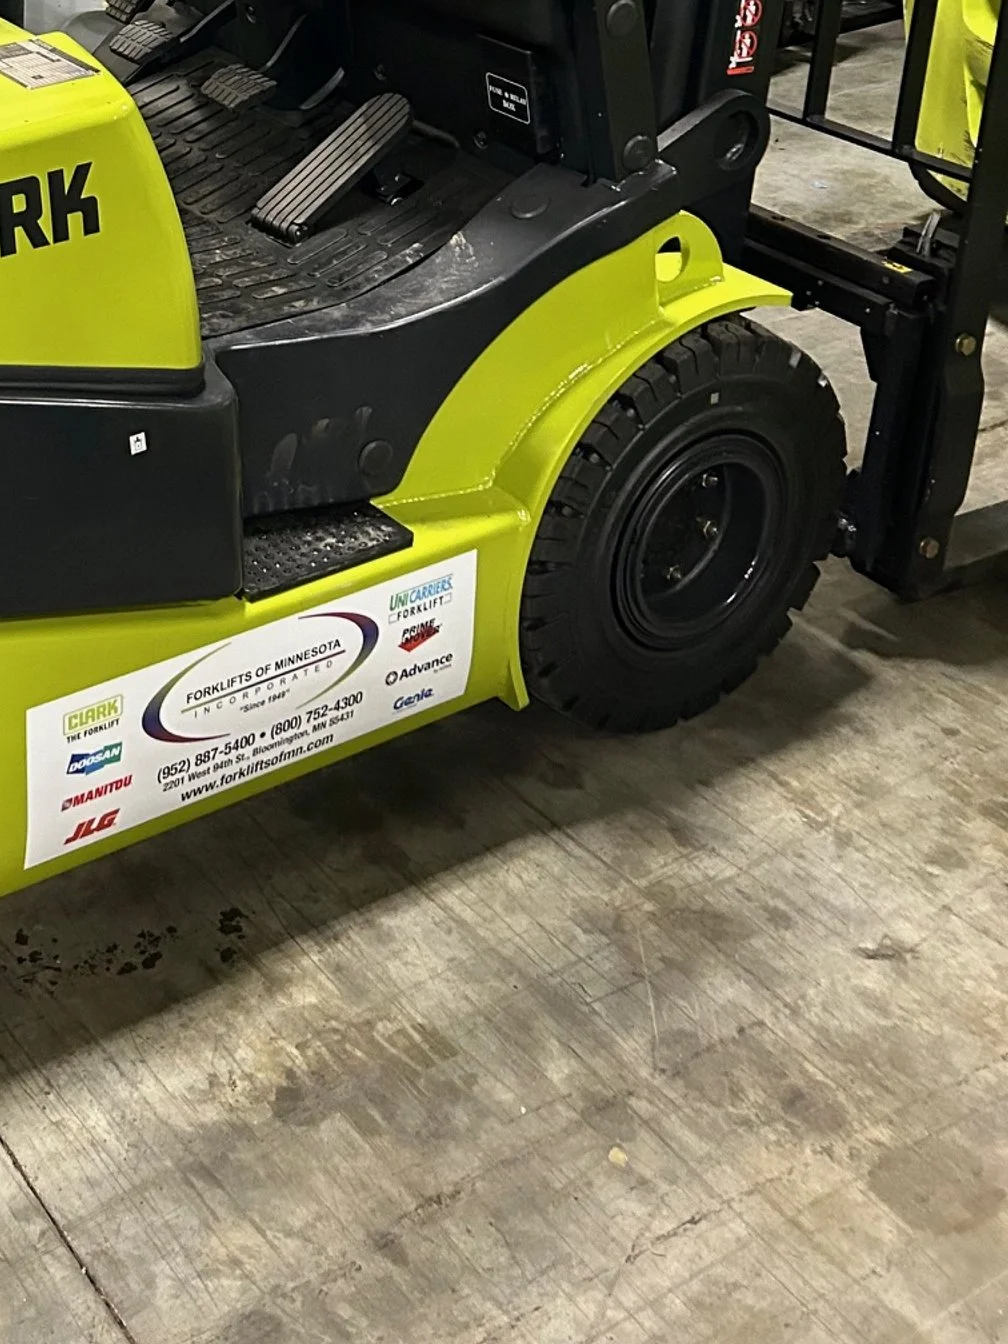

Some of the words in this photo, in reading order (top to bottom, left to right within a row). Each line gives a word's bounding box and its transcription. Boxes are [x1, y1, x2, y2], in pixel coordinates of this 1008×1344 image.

[397, 596, 445, 621] FORKLIFT
[186, 669, 253, 704] FORKLIFTS
[255, 663, 272, 678] OF
[274, 639, 342, 672] MINNESOTA
[399, 653, 454, 681] Advance
[194, 660, 333, 718] INCORPORATED
[393, 688, 434, 710] Genie
[66, 734, 81, 744] THE
[83, 718, 120, 737] FORKLIFT
[68, 699, 119, 731] CLARK
[157, 759, 191, 785] (952)
[194, 733, 256, 768] 887-5400
[270, 714, 303, 740] (800)
[306, 691, 364, 724] 752-4300
[162, 778, 185, 792] 2201
[187, 769, 211, 783] West
[212, 759, 234, 774] 94th
[252, 732, 310, 757] Bloomington,
[311, 722, 327, 734] MN
[328, 710, 355, 729] 55431
[69, 746, 121, 773] DOOSAN
[180, 733, 335, 802] www.forkliftsofmn.com
[72, 774, 133, 808] MANITOU
[64, 807, 121, 845] JLG
